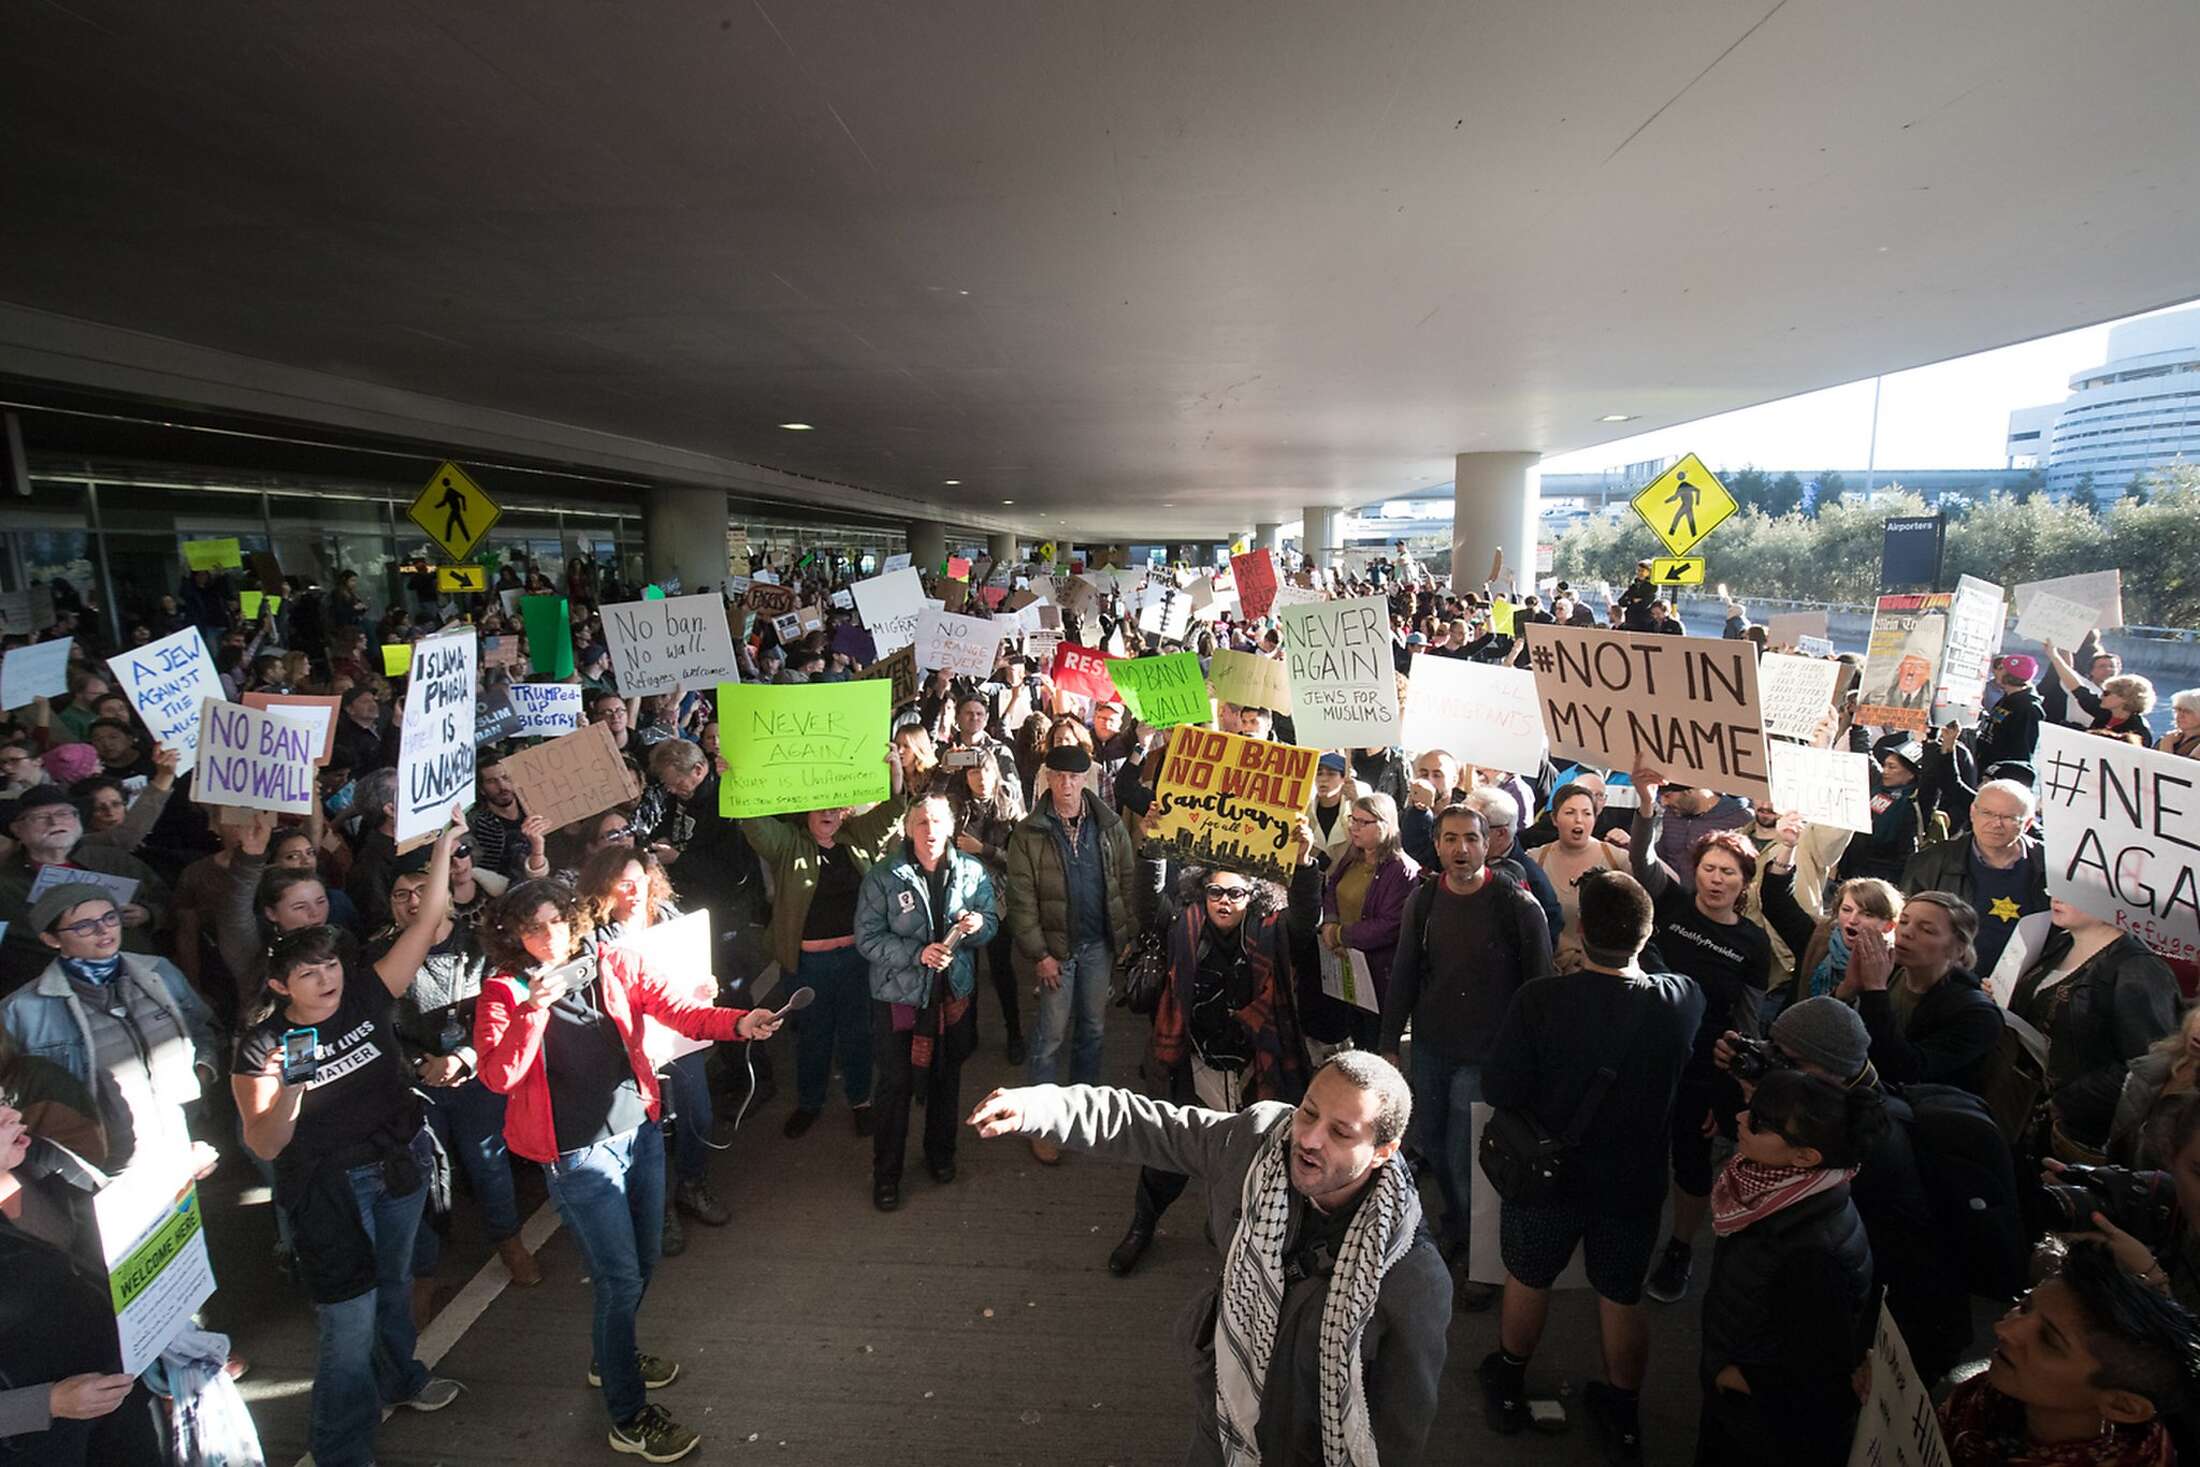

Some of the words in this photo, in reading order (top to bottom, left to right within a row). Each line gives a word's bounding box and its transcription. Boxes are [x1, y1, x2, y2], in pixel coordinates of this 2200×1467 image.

[1887, 521, 1933, 532] Airporters
[614, 610, 653, 643] No
[664, 604, 707, 637] ban.
[872, 616, 918, 634] MIGRA
[936, 623, 968, 638] NO
[1285, 607, 1385, 649] NEVER
[132, 660, 157, 686] A
[155, 634, 200, 673] JEW
[626, 648, 650, 673] No
[666, 634, 705, 659] wall.
[930, 652, 986, 669] FEVER
[931, 639, 988, 658] ORANGE
[1064, 651, 1104, 676] RES
[1292, 647, 1379, 681] AGAIN
[1116, 665, 1142, 692] NO
[1532, 639, 1662, 695] #NOT
[1685, 650, 1747, 706] IN
[137, 668, 200, 711] AGAINST
[1303, 690, 1347, 706] JEWS
[1353, 689, 1382, 705] FOR
[161, 695, 192, 718] THE
[478, 707, 512, 728] SLIM
[518, 713, 576, 728] BIGOTRY
[528, 702, 549, 713] UP
[1323, 706, 1392, 723] MUSLIMS
[161, 714, 199, 741] MUS
[211, 706, 249, 750] NO
[259, 719, 310, 764] BAN
[441, 713, 455, 744] IS
[753, 710, 849, 736] NEVER
[769, 733, 869, 761] AGAIN!
[1177, 729, 1229, 763] NO
[1239, 740, 1312, 779] BAN
[1548, 698, 1612, 753] MY
[1626, 709, 1768, 783] NAME
[522, 738, 578, 783] NOT
[529, 757, 609, 796] THIS
[207, 755, 248, 793] NO
[252, 760, 311, 802] WALL
[1167, 757, 1214, 791] NO
[1220, 767, 1304, 811] WALL
[2045, 750, 2200, 851] #NE
[1199, 816, 1219, 832] for
[1221, 821, 1242, 833] all
[2066, 827, 2200, 933] AGA
[1668, 923, 1745, 964] #NotMyPresident
[338, 1020, 375, 1051] LIVES
[313, 1047, 374, 1084] MATTER
[120, 1237, 173, 1299] WELCOME
